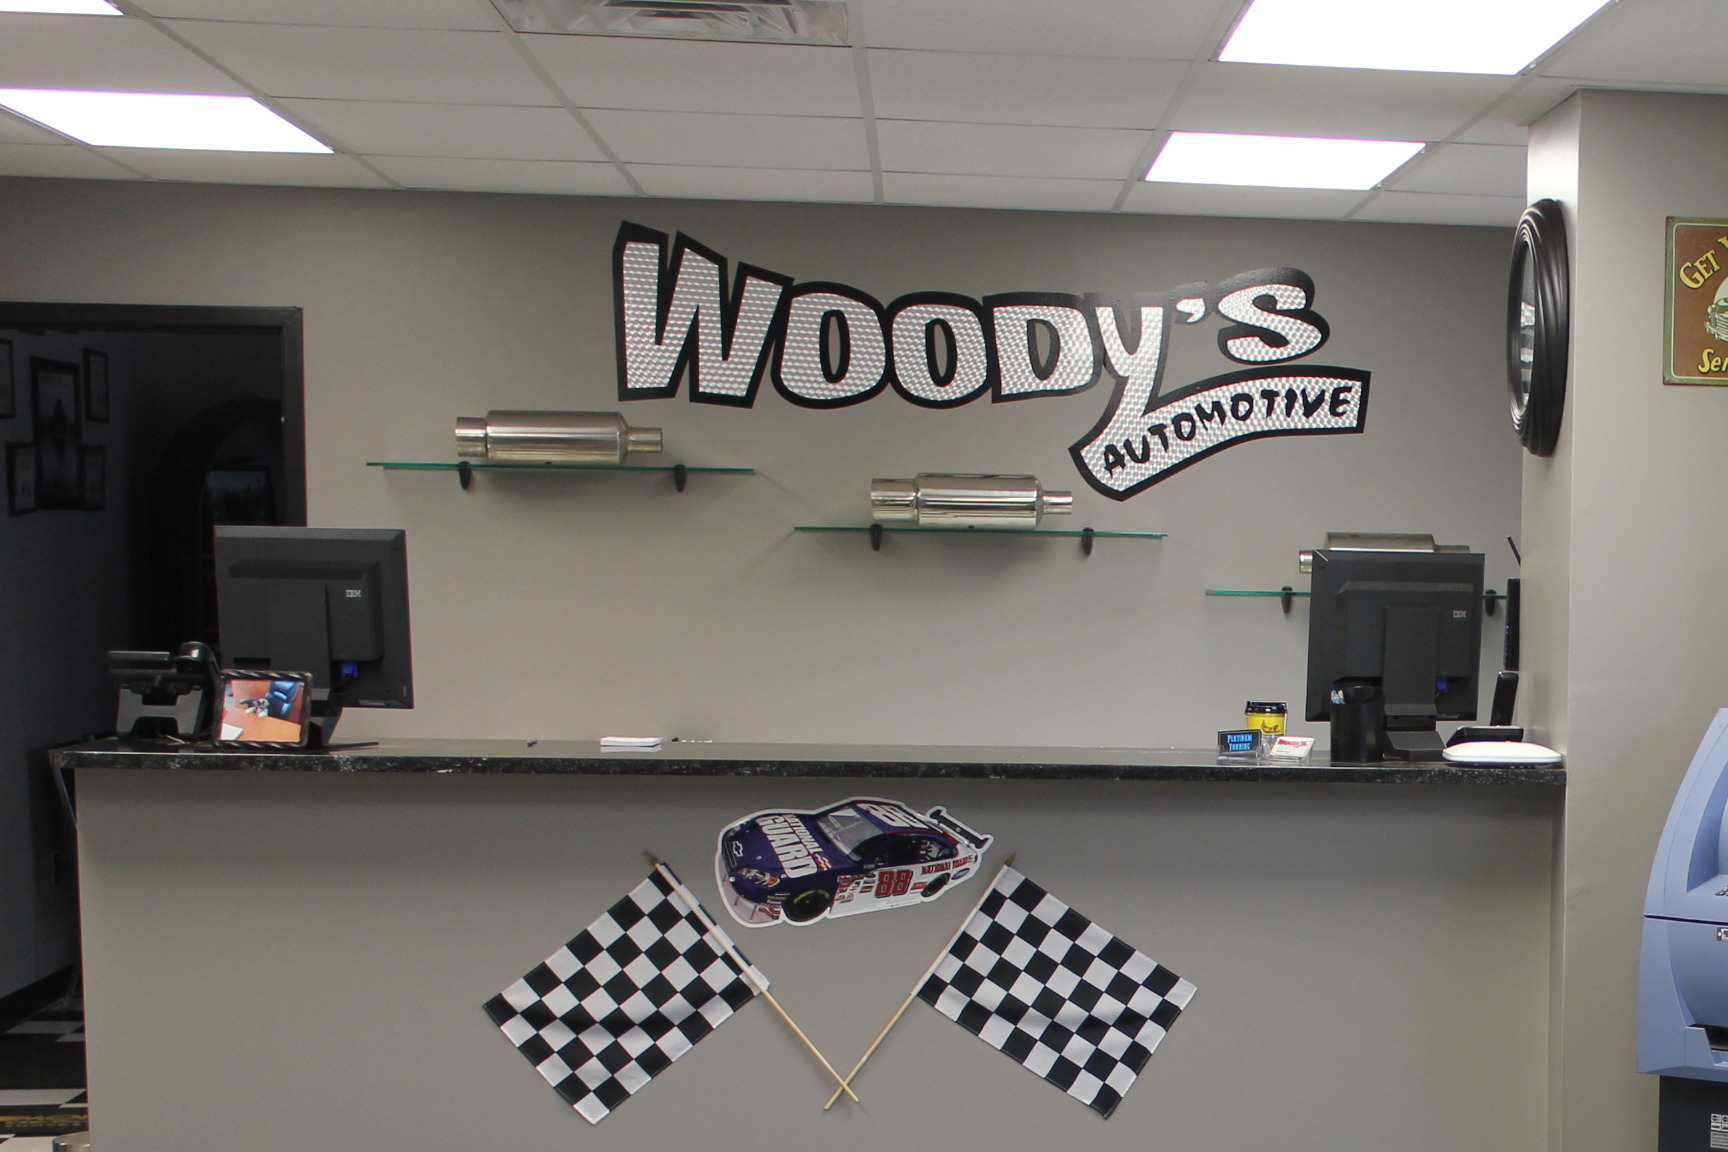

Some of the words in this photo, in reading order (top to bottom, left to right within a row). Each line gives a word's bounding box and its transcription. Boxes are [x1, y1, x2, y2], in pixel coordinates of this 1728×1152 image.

[1679, 249, 1721, 289] GET
[613, 220, 1330, 430] WOODY'S
[1103, 386, 1353, 479] AUTOMOTIVE
[345, 589, 362, 598] IBM
[1452, 609, 1467, 619] IBM
[755, 814, 818, 879] GUARD
[874, 869, 914, 899] 88
